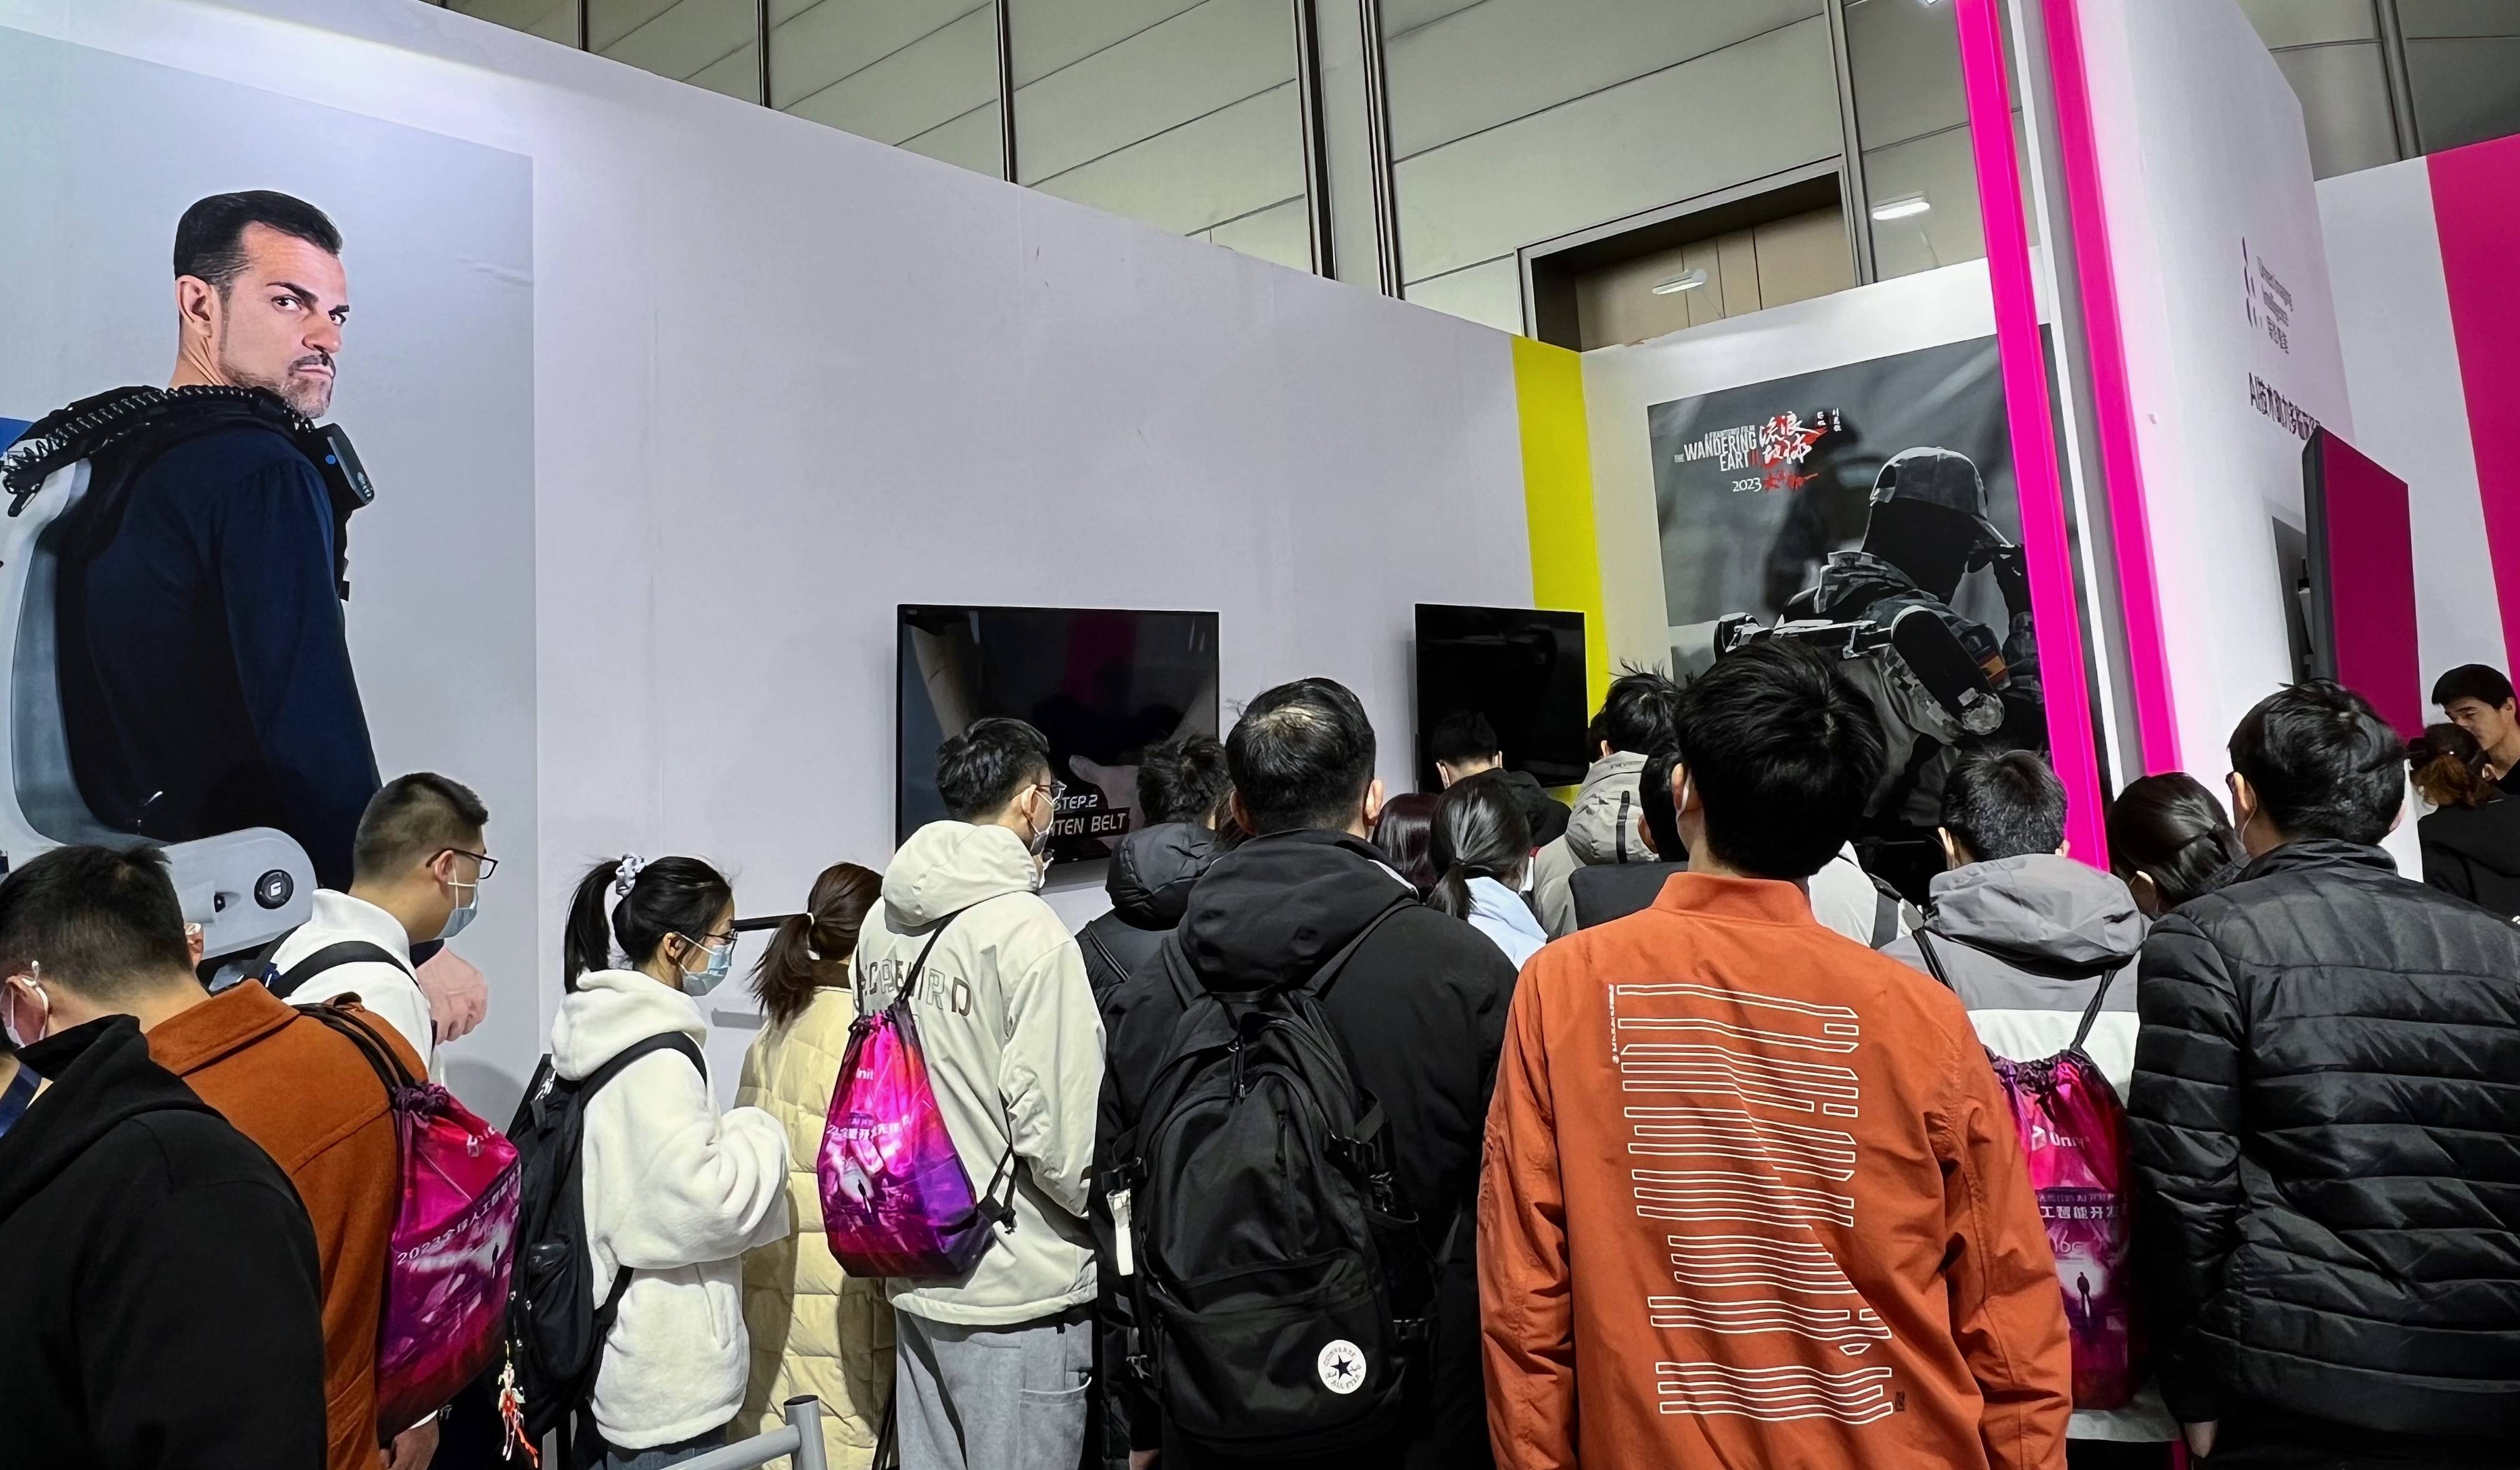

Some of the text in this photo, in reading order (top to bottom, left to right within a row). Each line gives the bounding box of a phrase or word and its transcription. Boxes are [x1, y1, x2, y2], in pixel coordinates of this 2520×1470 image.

[1683, 431, 1757, 461] WANDERING
[1732, 477, 1762, 493] 2023
[1091, 813, 1127, 833] BELT
